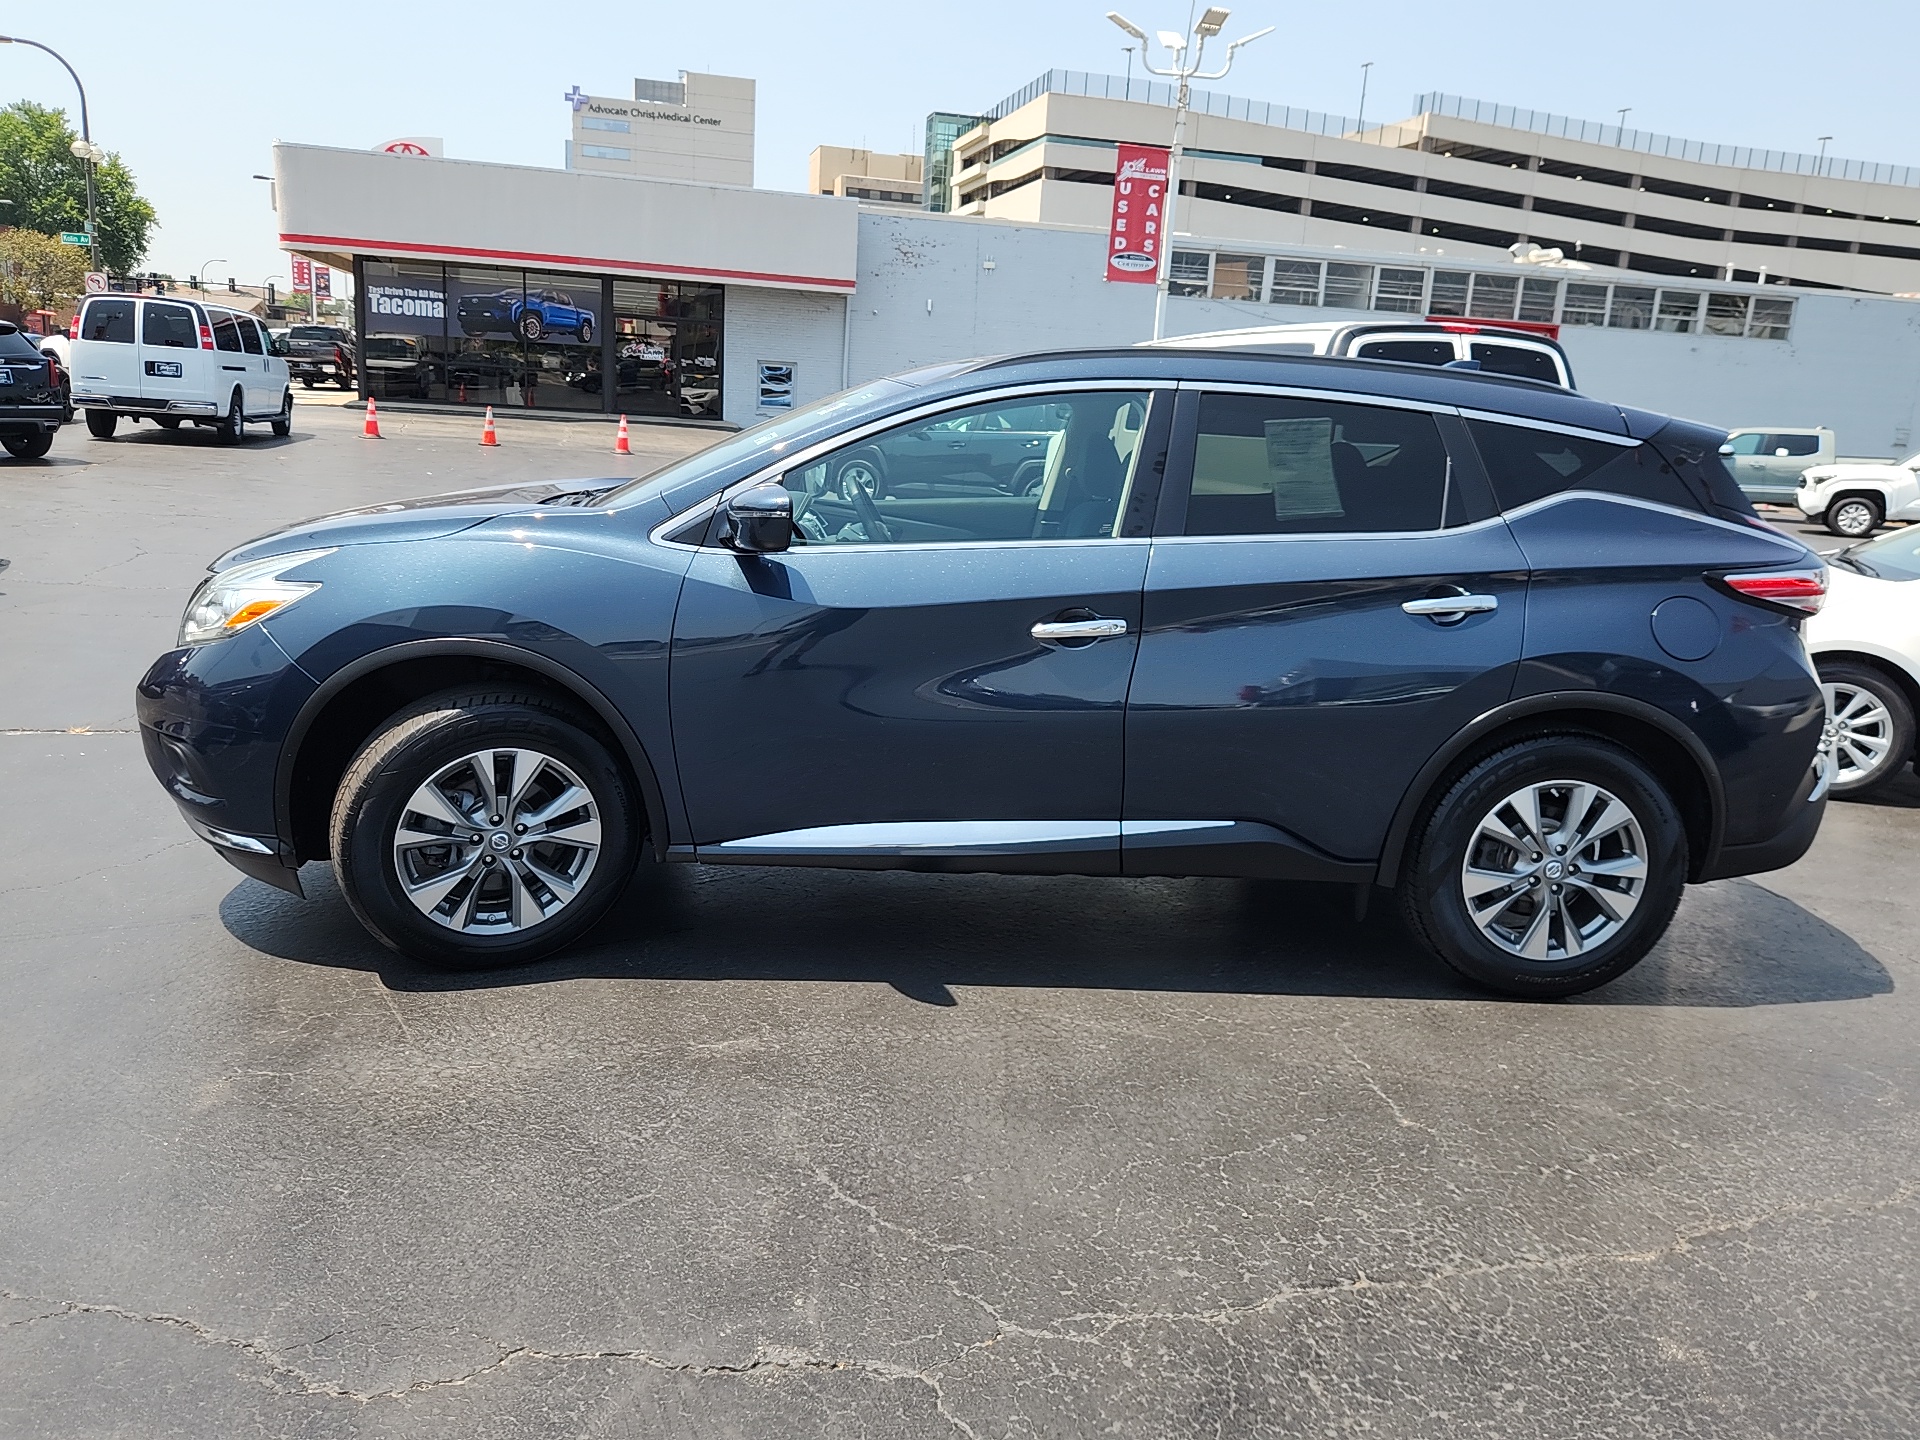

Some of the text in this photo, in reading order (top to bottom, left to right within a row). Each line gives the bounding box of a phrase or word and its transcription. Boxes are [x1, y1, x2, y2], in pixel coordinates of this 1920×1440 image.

[588, 104, 722, 126] Advocate Christ Medical Center
[1114, 182, 1131, 250] USED
[1143, 185, 1160, 252] CARS
[368, 285, 384, 294] Test
[385, 287, 403, 296] Drive
[404, 288, 417, 297] The
[368, 293, 449, 318] Tacoma
